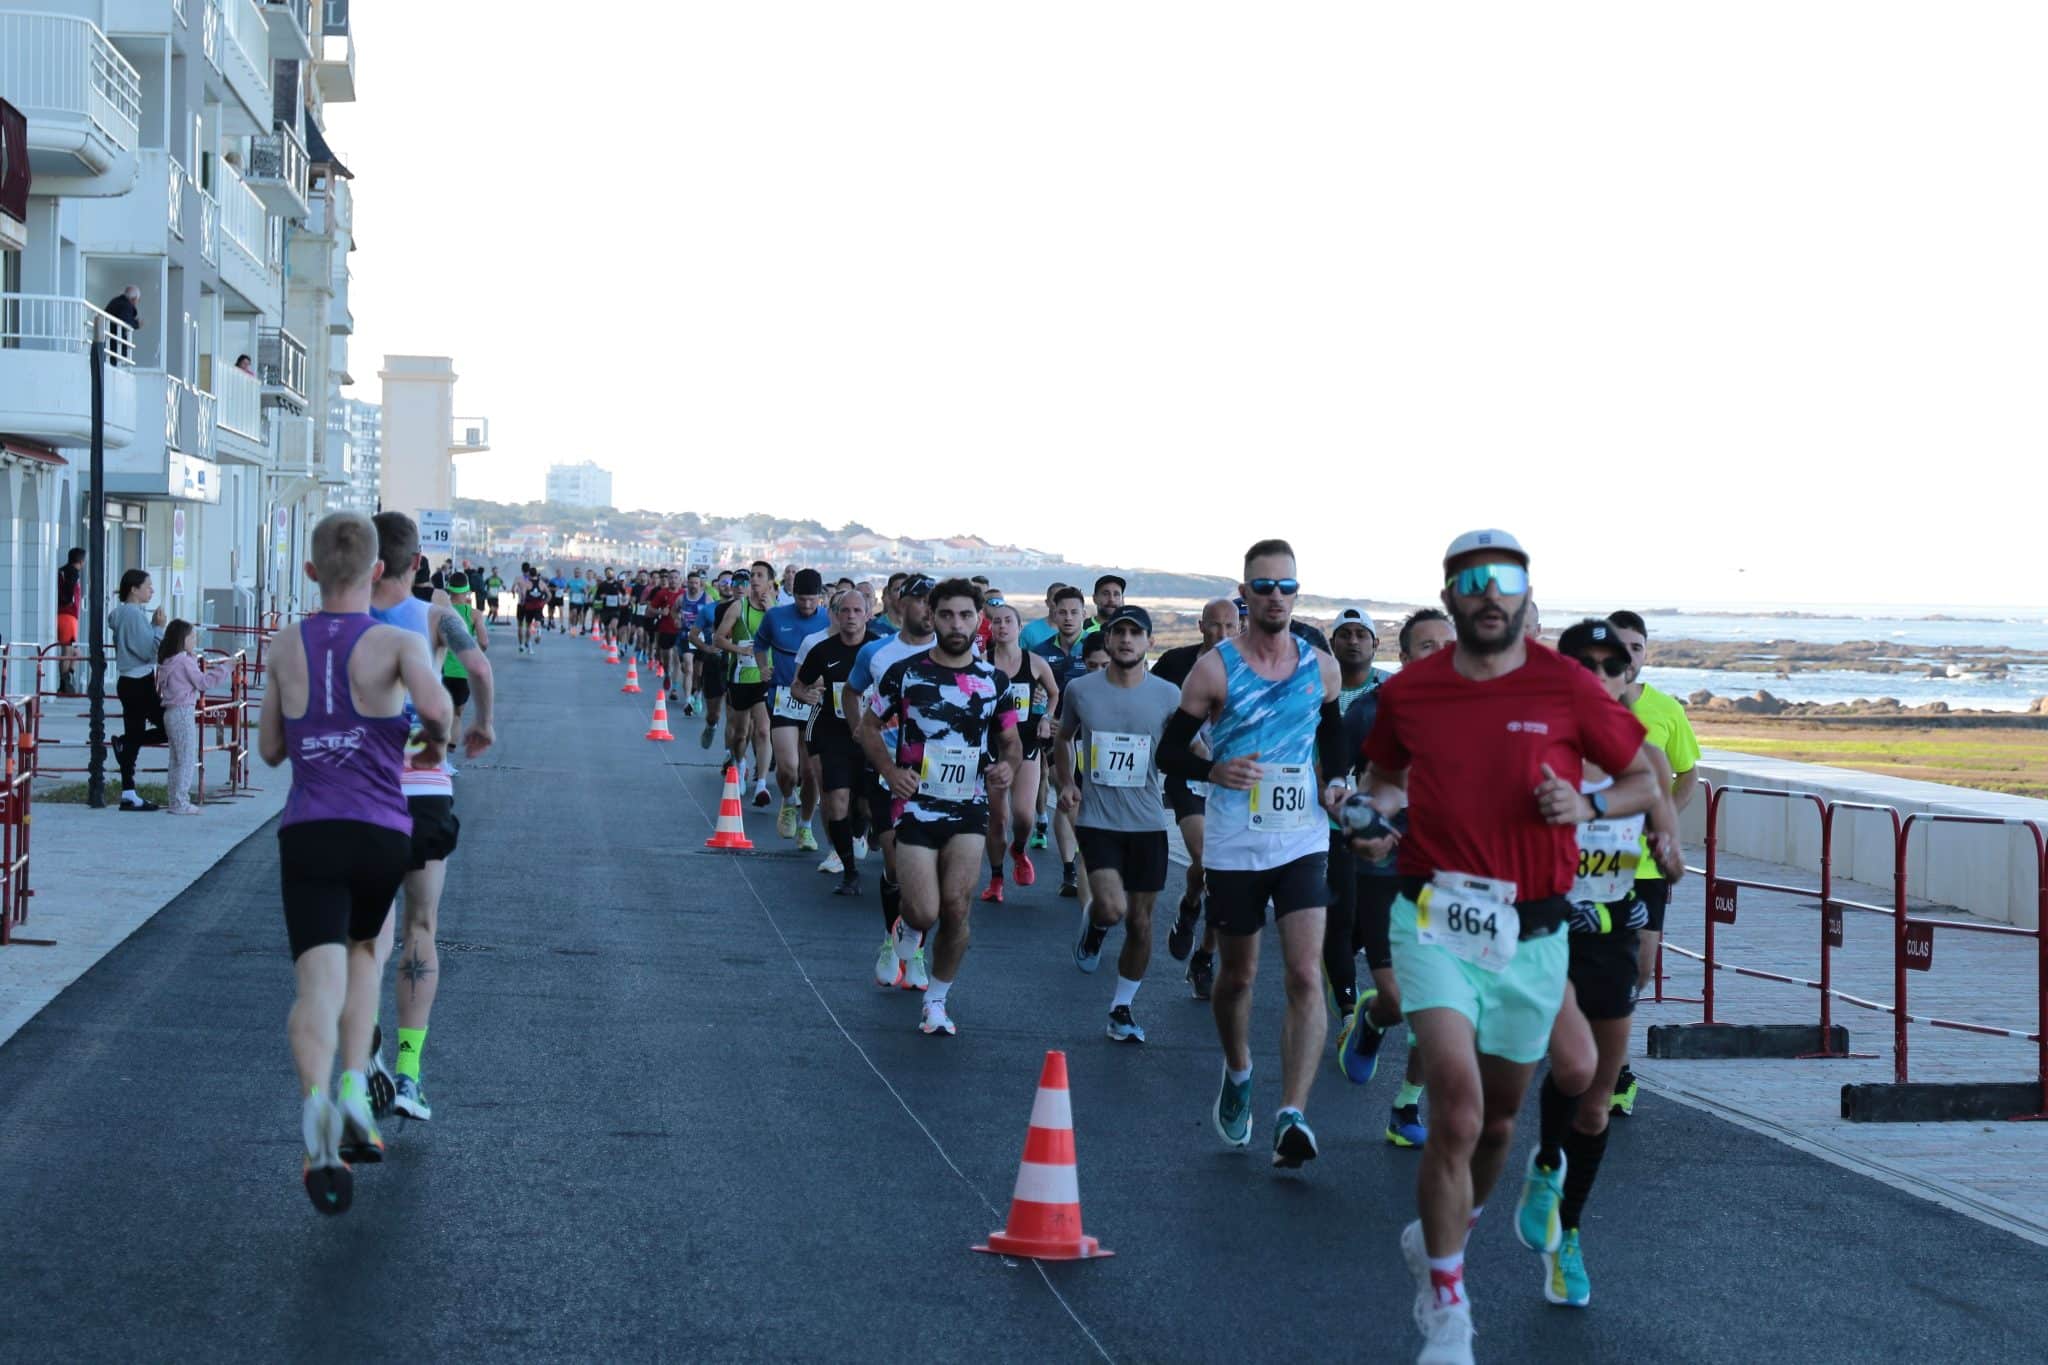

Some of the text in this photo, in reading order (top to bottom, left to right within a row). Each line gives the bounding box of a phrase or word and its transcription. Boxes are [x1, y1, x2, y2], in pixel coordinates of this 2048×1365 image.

[434, 530, 448, 541] 19
[1109, 751, 1135, 770] 774
[940, 763, 965, 783] 770
[1272, 785, 1305, 811] 630
[1577, 848, 1621, 878] 824
[1715, 896, 1734, 911] COLAS
[1447, 902, 1498, 941] 864
[1907, 940, 1929, 957] COLAS
